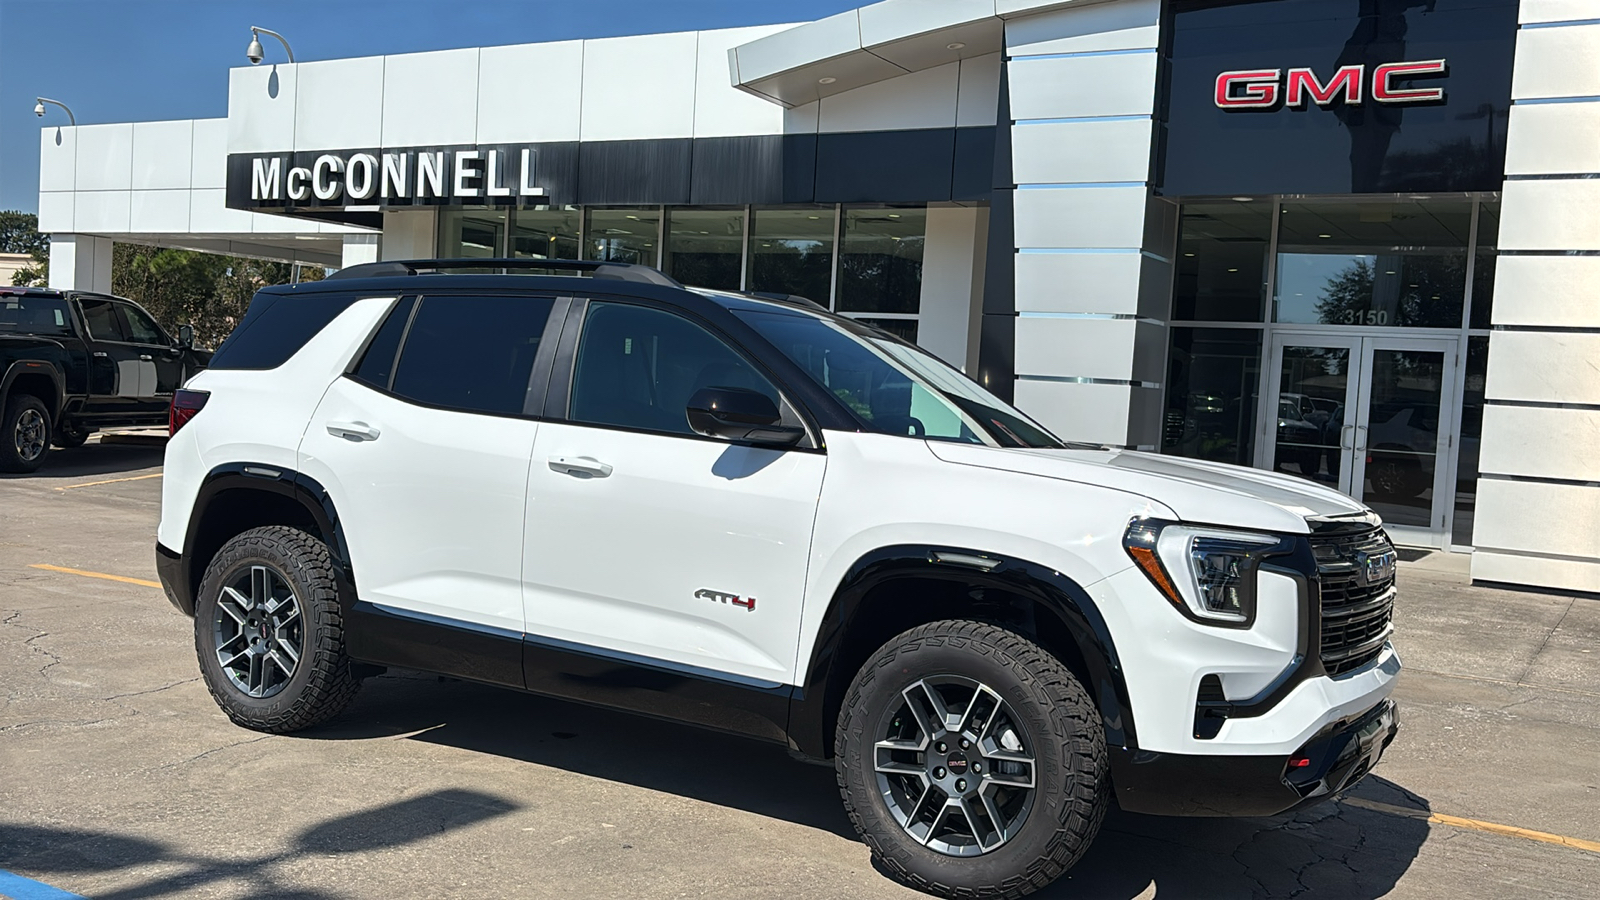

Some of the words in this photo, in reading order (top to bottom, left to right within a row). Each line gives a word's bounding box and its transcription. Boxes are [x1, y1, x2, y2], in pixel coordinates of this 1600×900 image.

[1214, 59, 1446, 109] GMC
[251, 149, 544, 201] McCONNELL
[1344, 309, 1388, 325] 3150
[694, 588, 756, 612] AT4
[1009, 685, 1060, 812] GENERAL
[850, 749, 915, 862] GRABBER
